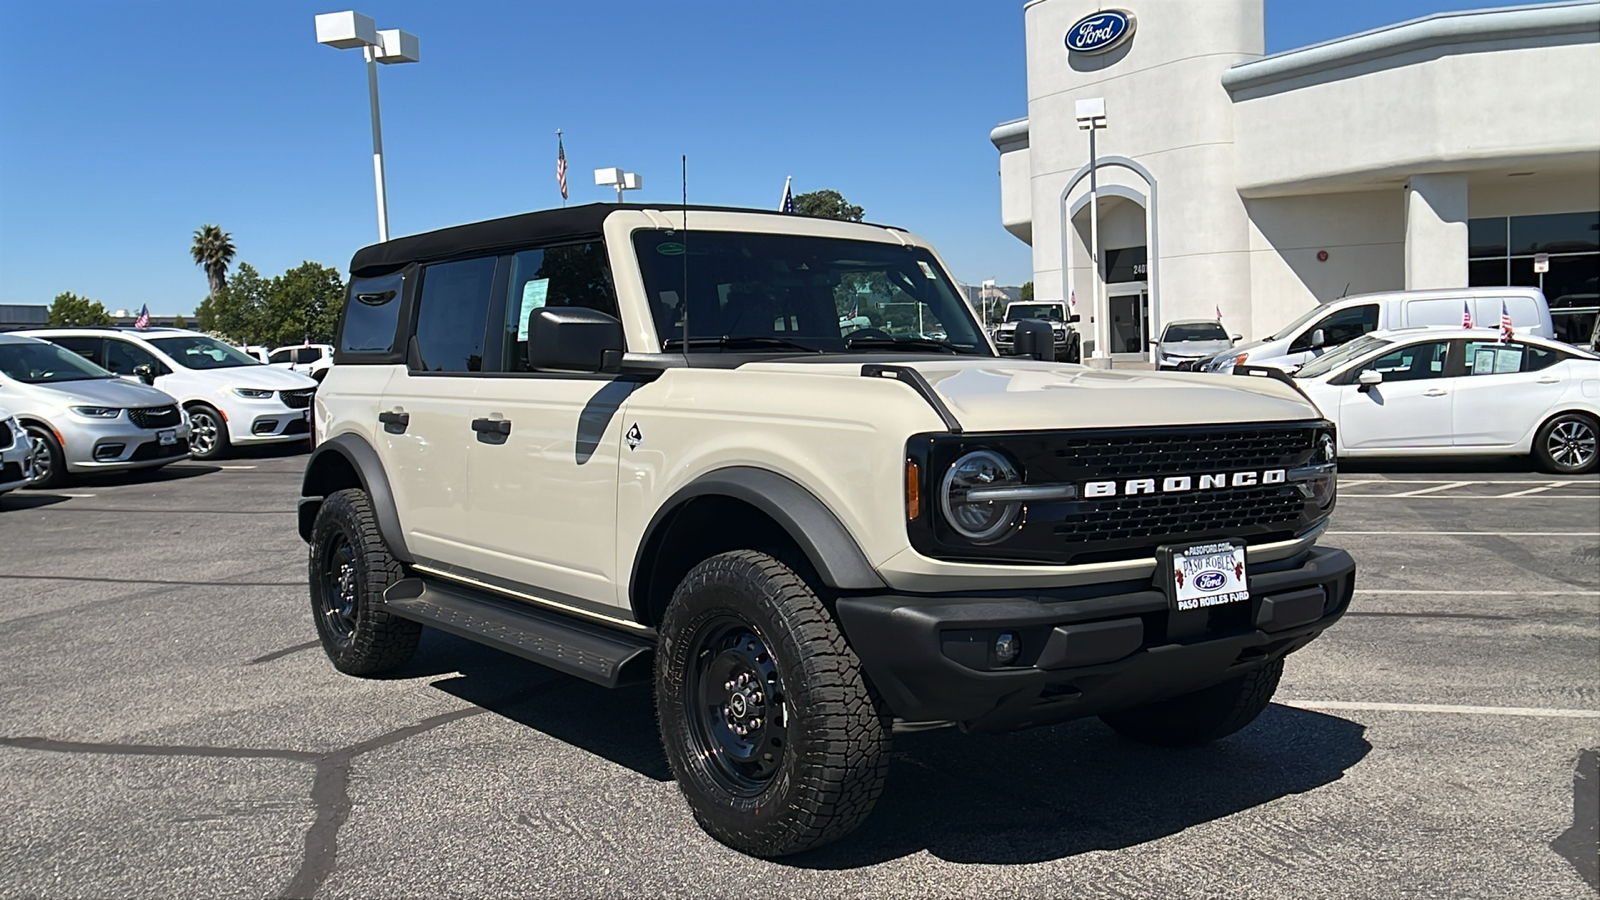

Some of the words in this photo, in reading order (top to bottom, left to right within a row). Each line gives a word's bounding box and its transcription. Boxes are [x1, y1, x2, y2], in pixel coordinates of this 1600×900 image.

[1076, 18, 1115, 47] Ford
[1084, 469, 1286, 498] BRONCO
[1183, 558, 1203, 578] PASO
[1205, 555, 1237, 572] ROBLES
[1200, 573, 1222, 588] Ford
[1178, 599, 1199, 611] PASO
[1200, 594, 1229, 607] ROBLES
[1229, 591, 1250, 602] FORD
